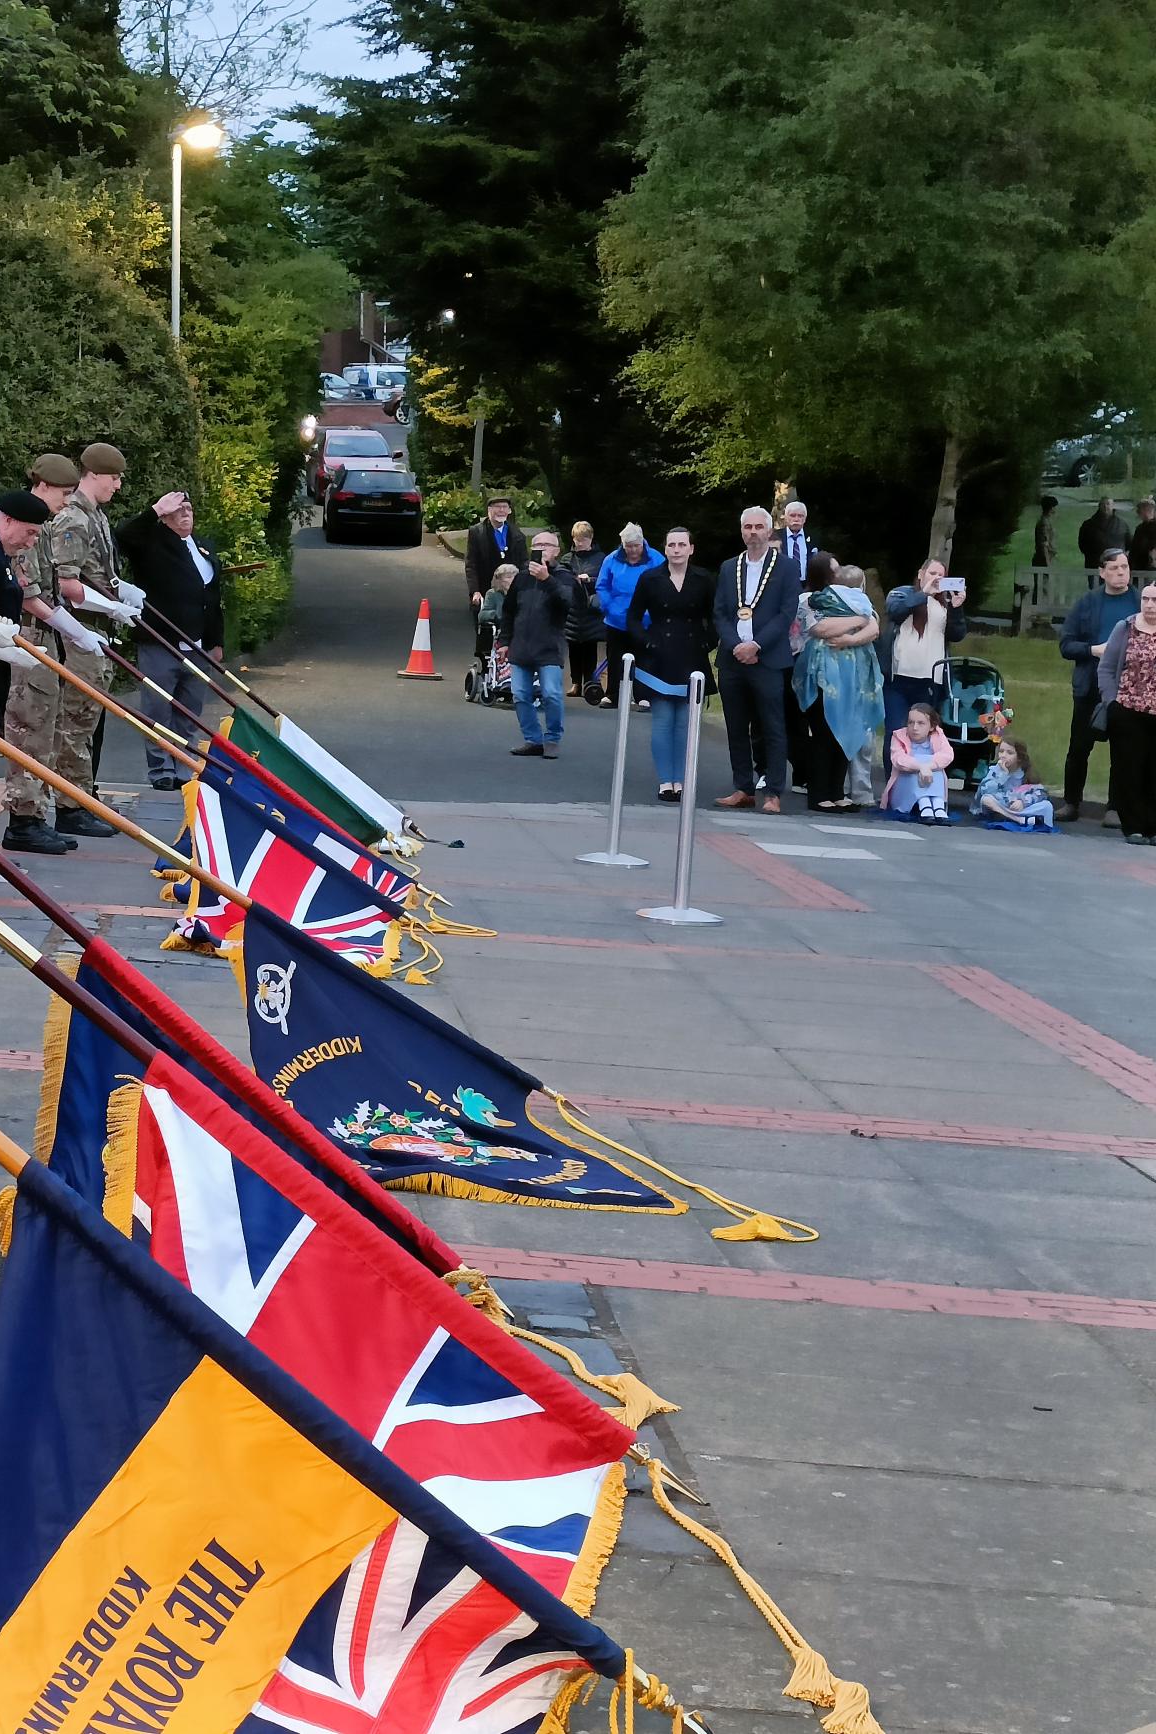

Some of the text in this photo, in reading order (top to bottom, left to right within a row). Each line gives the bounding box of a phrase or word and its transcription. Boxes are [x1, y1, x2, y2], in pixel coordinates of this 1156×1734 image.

[14, 1565, 153, 1734] KIDDERMIN
[80, 1537, 266, 1734] THE ROYA
